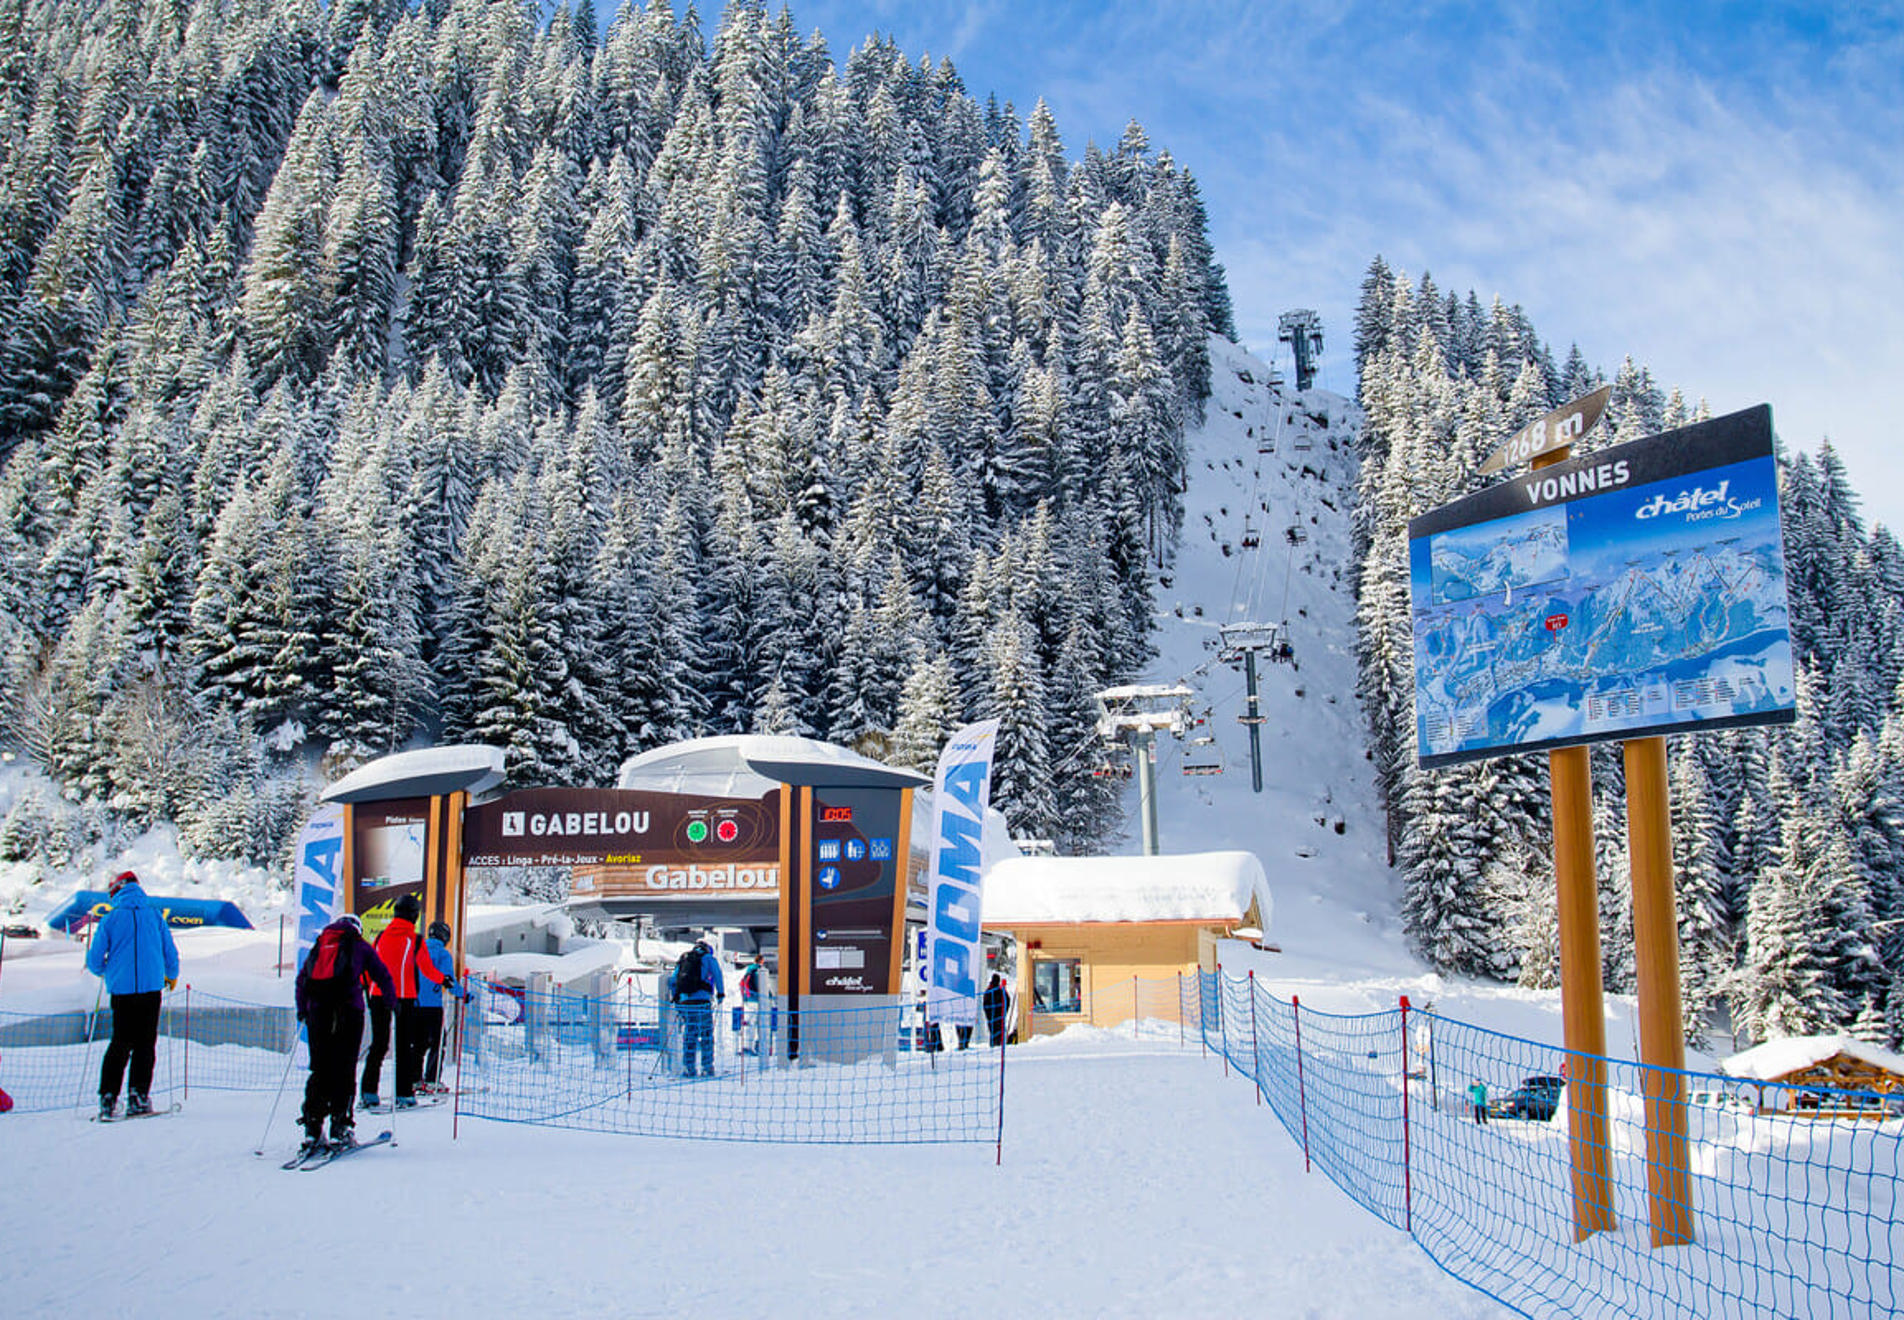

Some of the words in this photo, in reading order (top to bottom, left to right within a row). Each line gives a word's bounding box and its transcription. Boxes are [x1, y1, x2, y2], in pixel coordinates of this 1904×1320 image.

[1503, 420, 1547, 465] 1268
[1555, 412, 1583, 442] m
[1525, 460, 1630, 504] VONNES
[1635, 480, 1730, 519] châtel
[1715, 505, 1728, 517] du
[1721, 497, 1761, 519] Soleil
[1686, 509, 1714, 522] Portes
[530, 811, 650, 836] GABELOU
[468, 855, 500, 866] ACCES
[507, 855, 532, 867] Linga
[605, 853, 642, 864] Avoriaz
[646, 864, 778, 890] Gabelou
[933, 761, 988, 998] POMA
